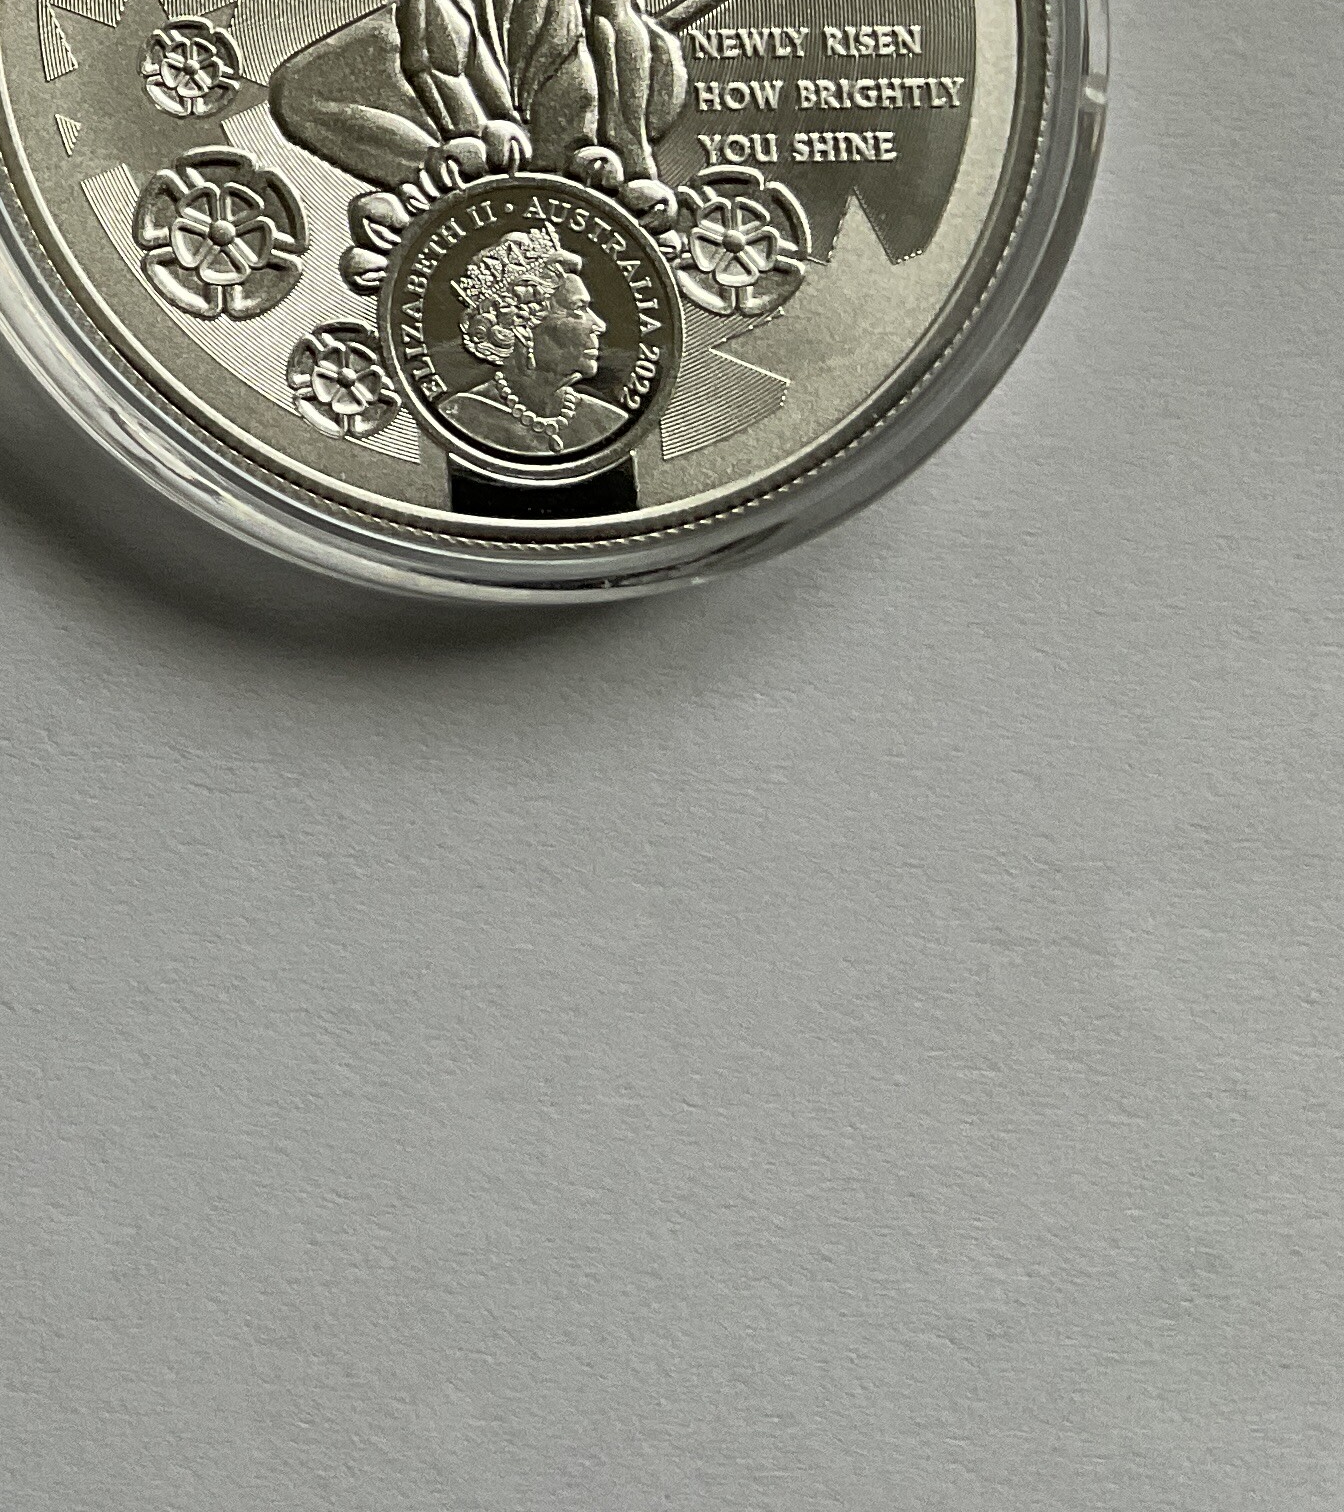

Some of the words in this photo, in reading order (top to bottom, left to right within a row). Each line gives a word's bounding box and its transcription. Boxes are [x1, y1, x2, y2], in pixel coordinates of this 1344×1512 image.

[689, 26, 810, 59] NEWLY
[823, 25, 922, 58] RISEN
[694, 79, 784, 111] HOW
[796, 77, 965, 110] BRIGHTLY
[698, 133, 778, 164] YOU
[792, 131, 898, 163] SHINE
[401, 217, 467, 402] ELIZABETH
[466, 200, 499, 229] II
[521, 196, 663, 338] AUSTRALIA
[620, 341, 661, 411] 2022
